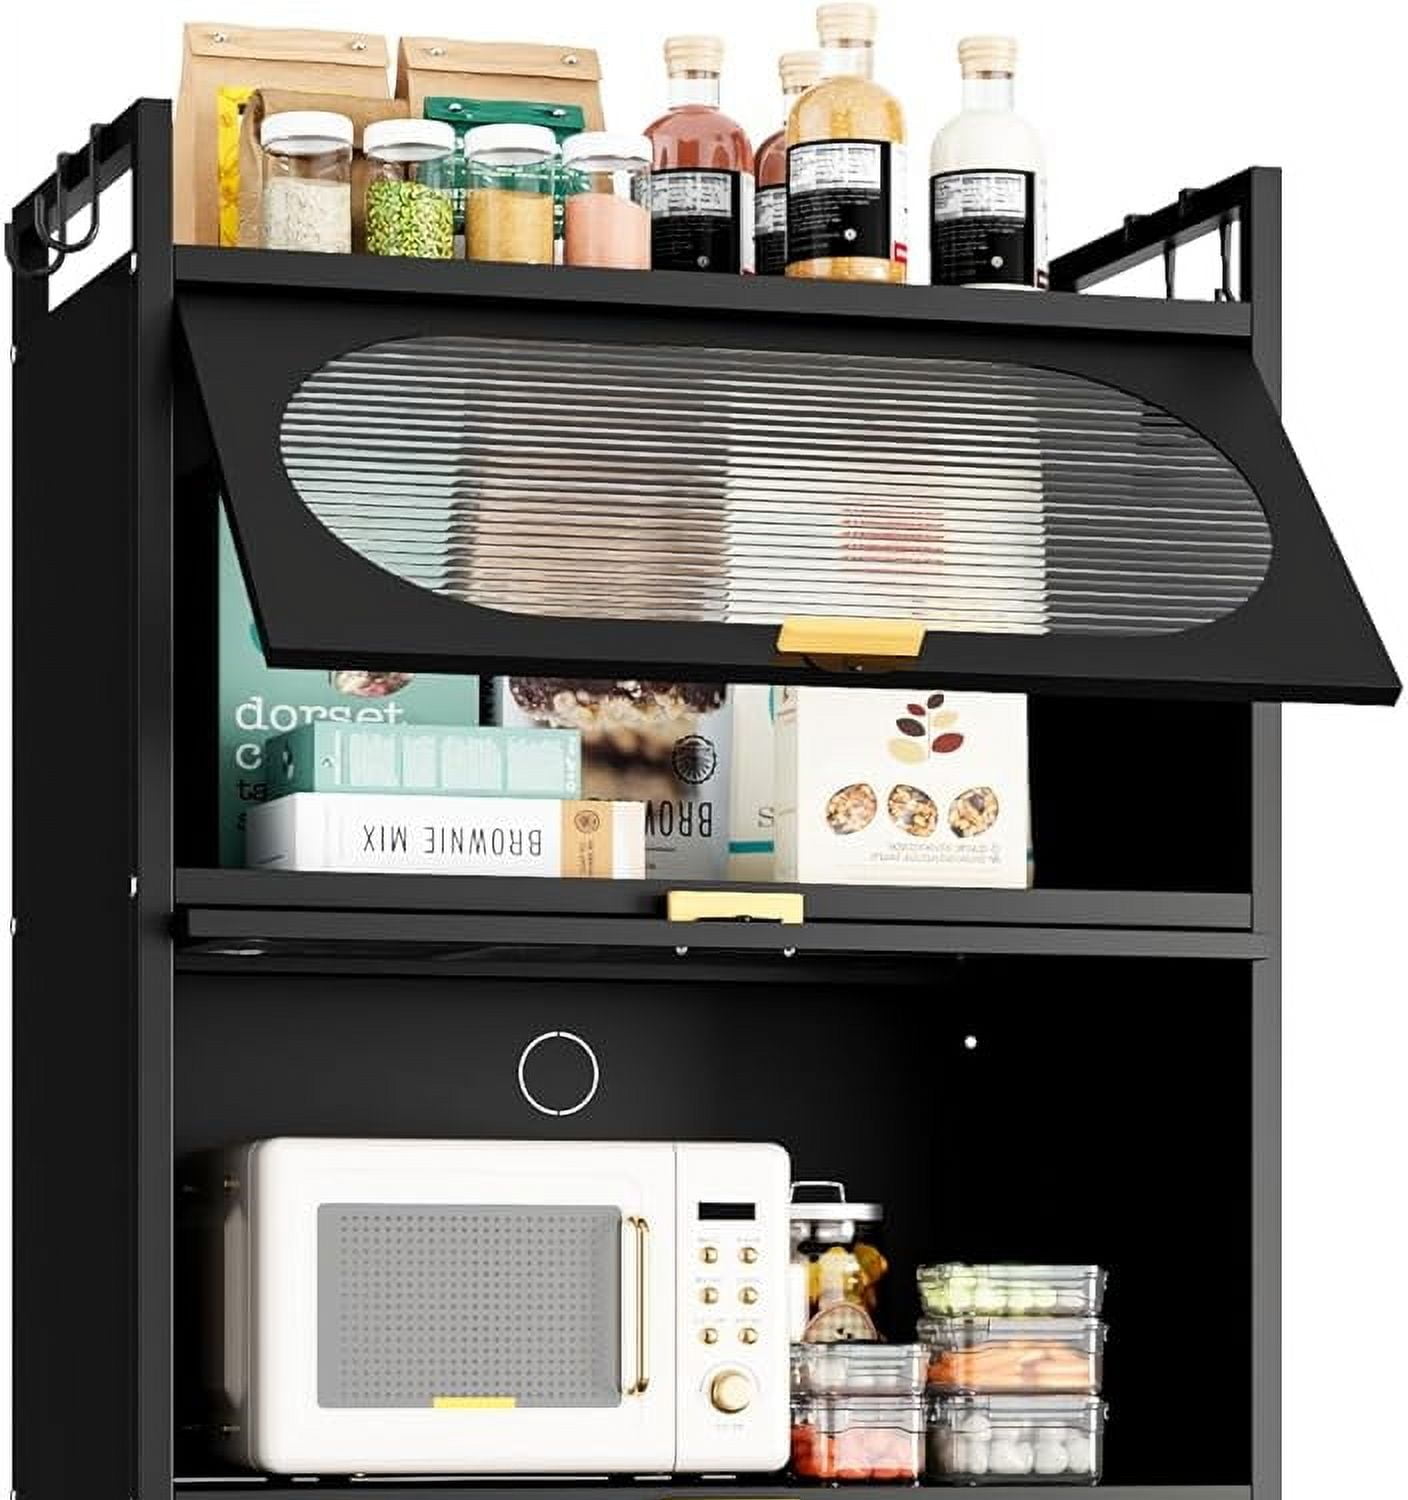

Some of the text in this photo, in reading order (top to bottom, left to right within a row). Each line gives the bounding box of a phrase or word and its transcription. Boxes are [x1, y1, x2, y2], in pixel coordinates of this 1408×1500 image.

[235, 696, 405, 732] dorset
[363, 824, 407, 853] MIX
[424, 826, 542, 857] BROWNIE
